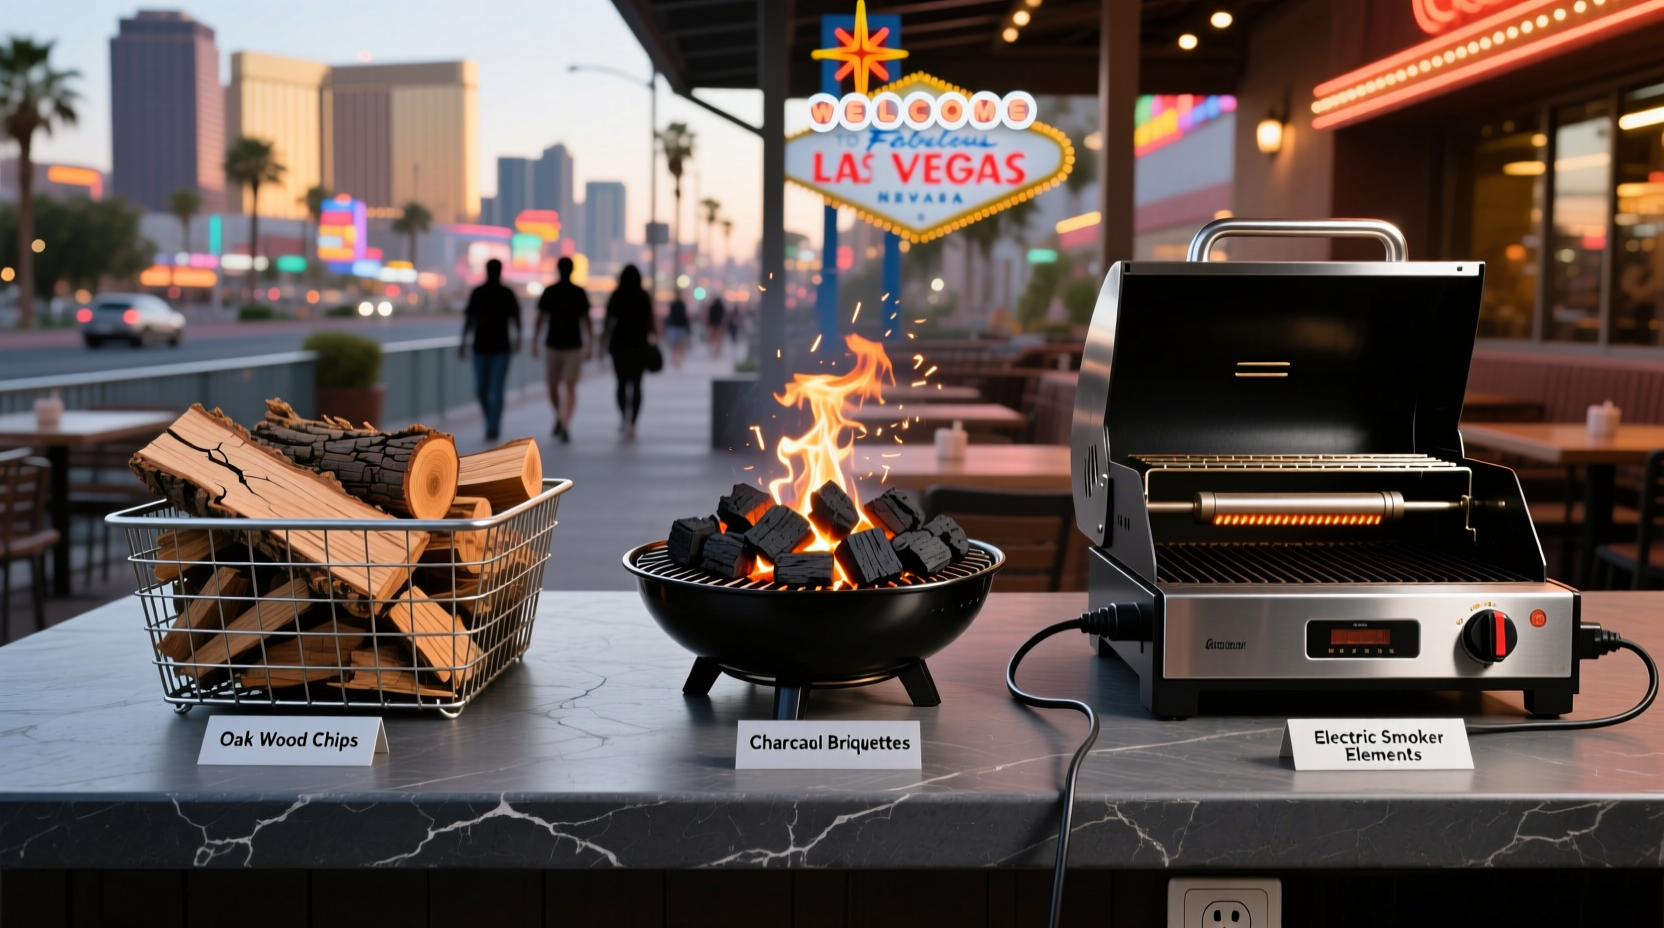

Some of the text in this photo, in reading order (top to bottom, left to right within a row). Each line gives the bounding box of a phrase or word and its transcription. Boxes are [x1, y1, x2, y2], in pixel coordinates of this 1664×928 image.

[810, 98, 1029, 125] WELCOME
[812, 151, 1026, 185] LAS VEGAS
[220, 731, 358, 751] Oak Wood Chips
[828, 734, 910, 755] Briquettes
[1314, 729, 1443, 744] Electric Smoker
[1345, 747, 1422, 761] Elements
